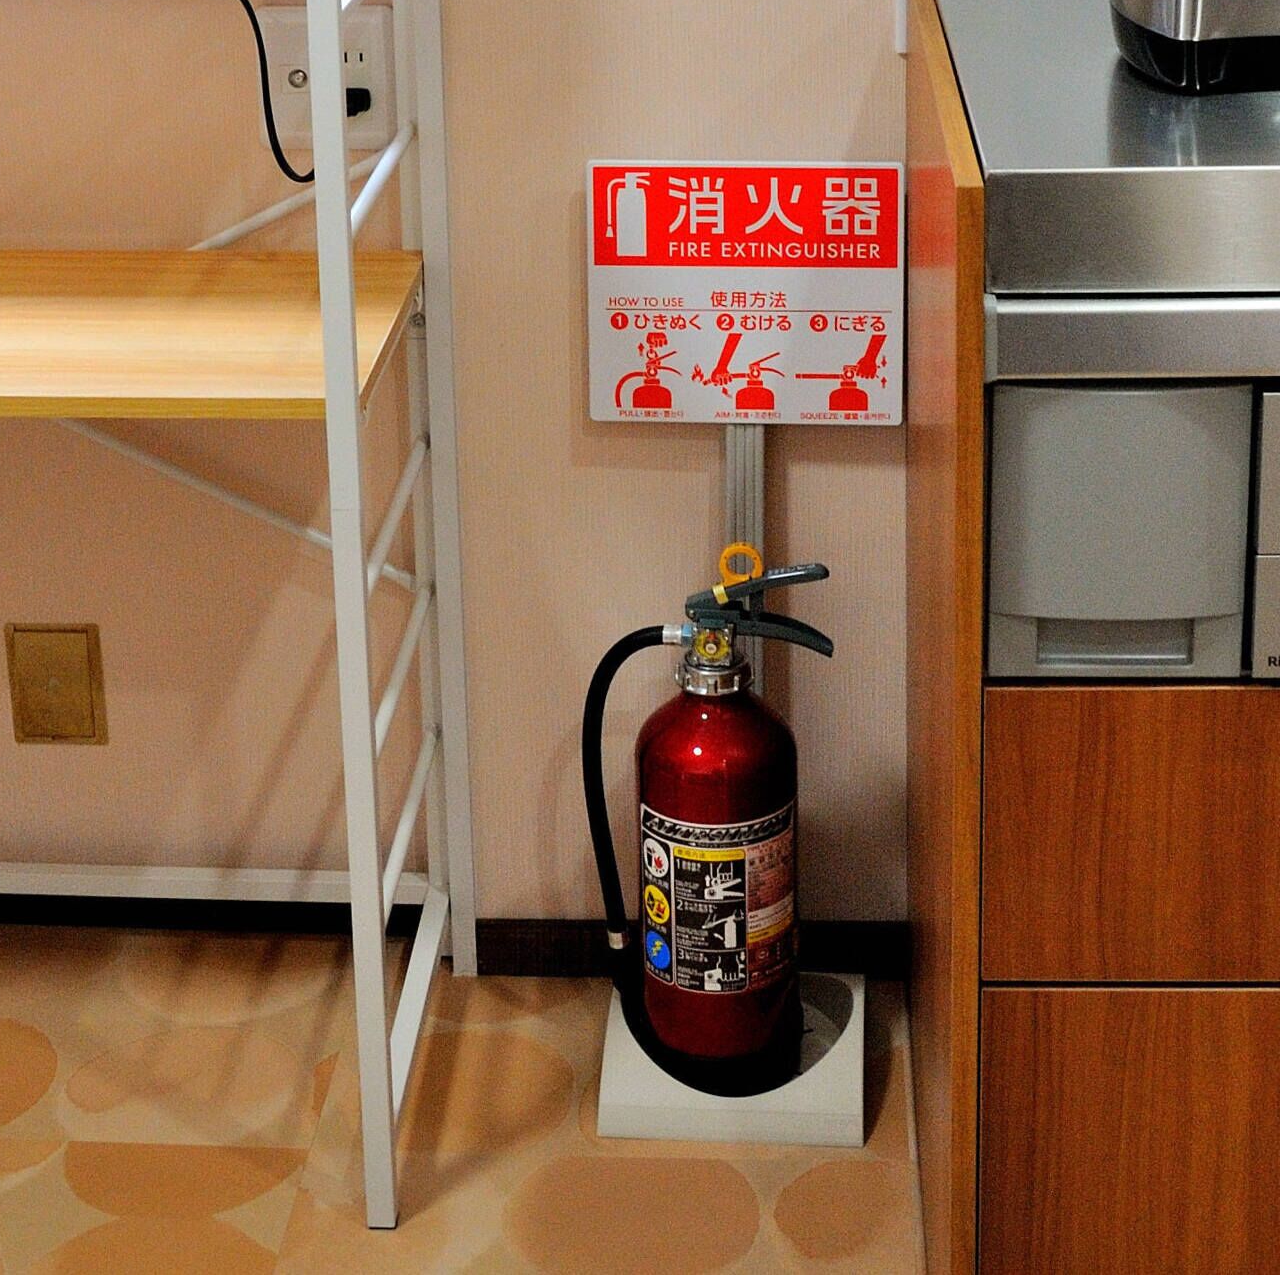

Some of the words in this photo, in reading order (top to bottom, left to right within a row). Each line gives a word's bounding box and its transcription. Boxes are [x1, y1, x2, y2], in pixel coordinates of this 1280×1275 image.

[667, 175, 881, 236] 消火器
[669, 241, 711, 258] FIRE
[721, 241, 881, 260] EXTINGUISHER
[608, 297, 639, 308] HOW
[643, 297, 658, 308] TO
[662, 297, 684, 308] USE
[710, 291, 788, 309] 使用方法
[634, 314, 702, 331] ひきぬく
[740, 315, 792, 332] むける
[834, 316, 887, 332] にぎる
